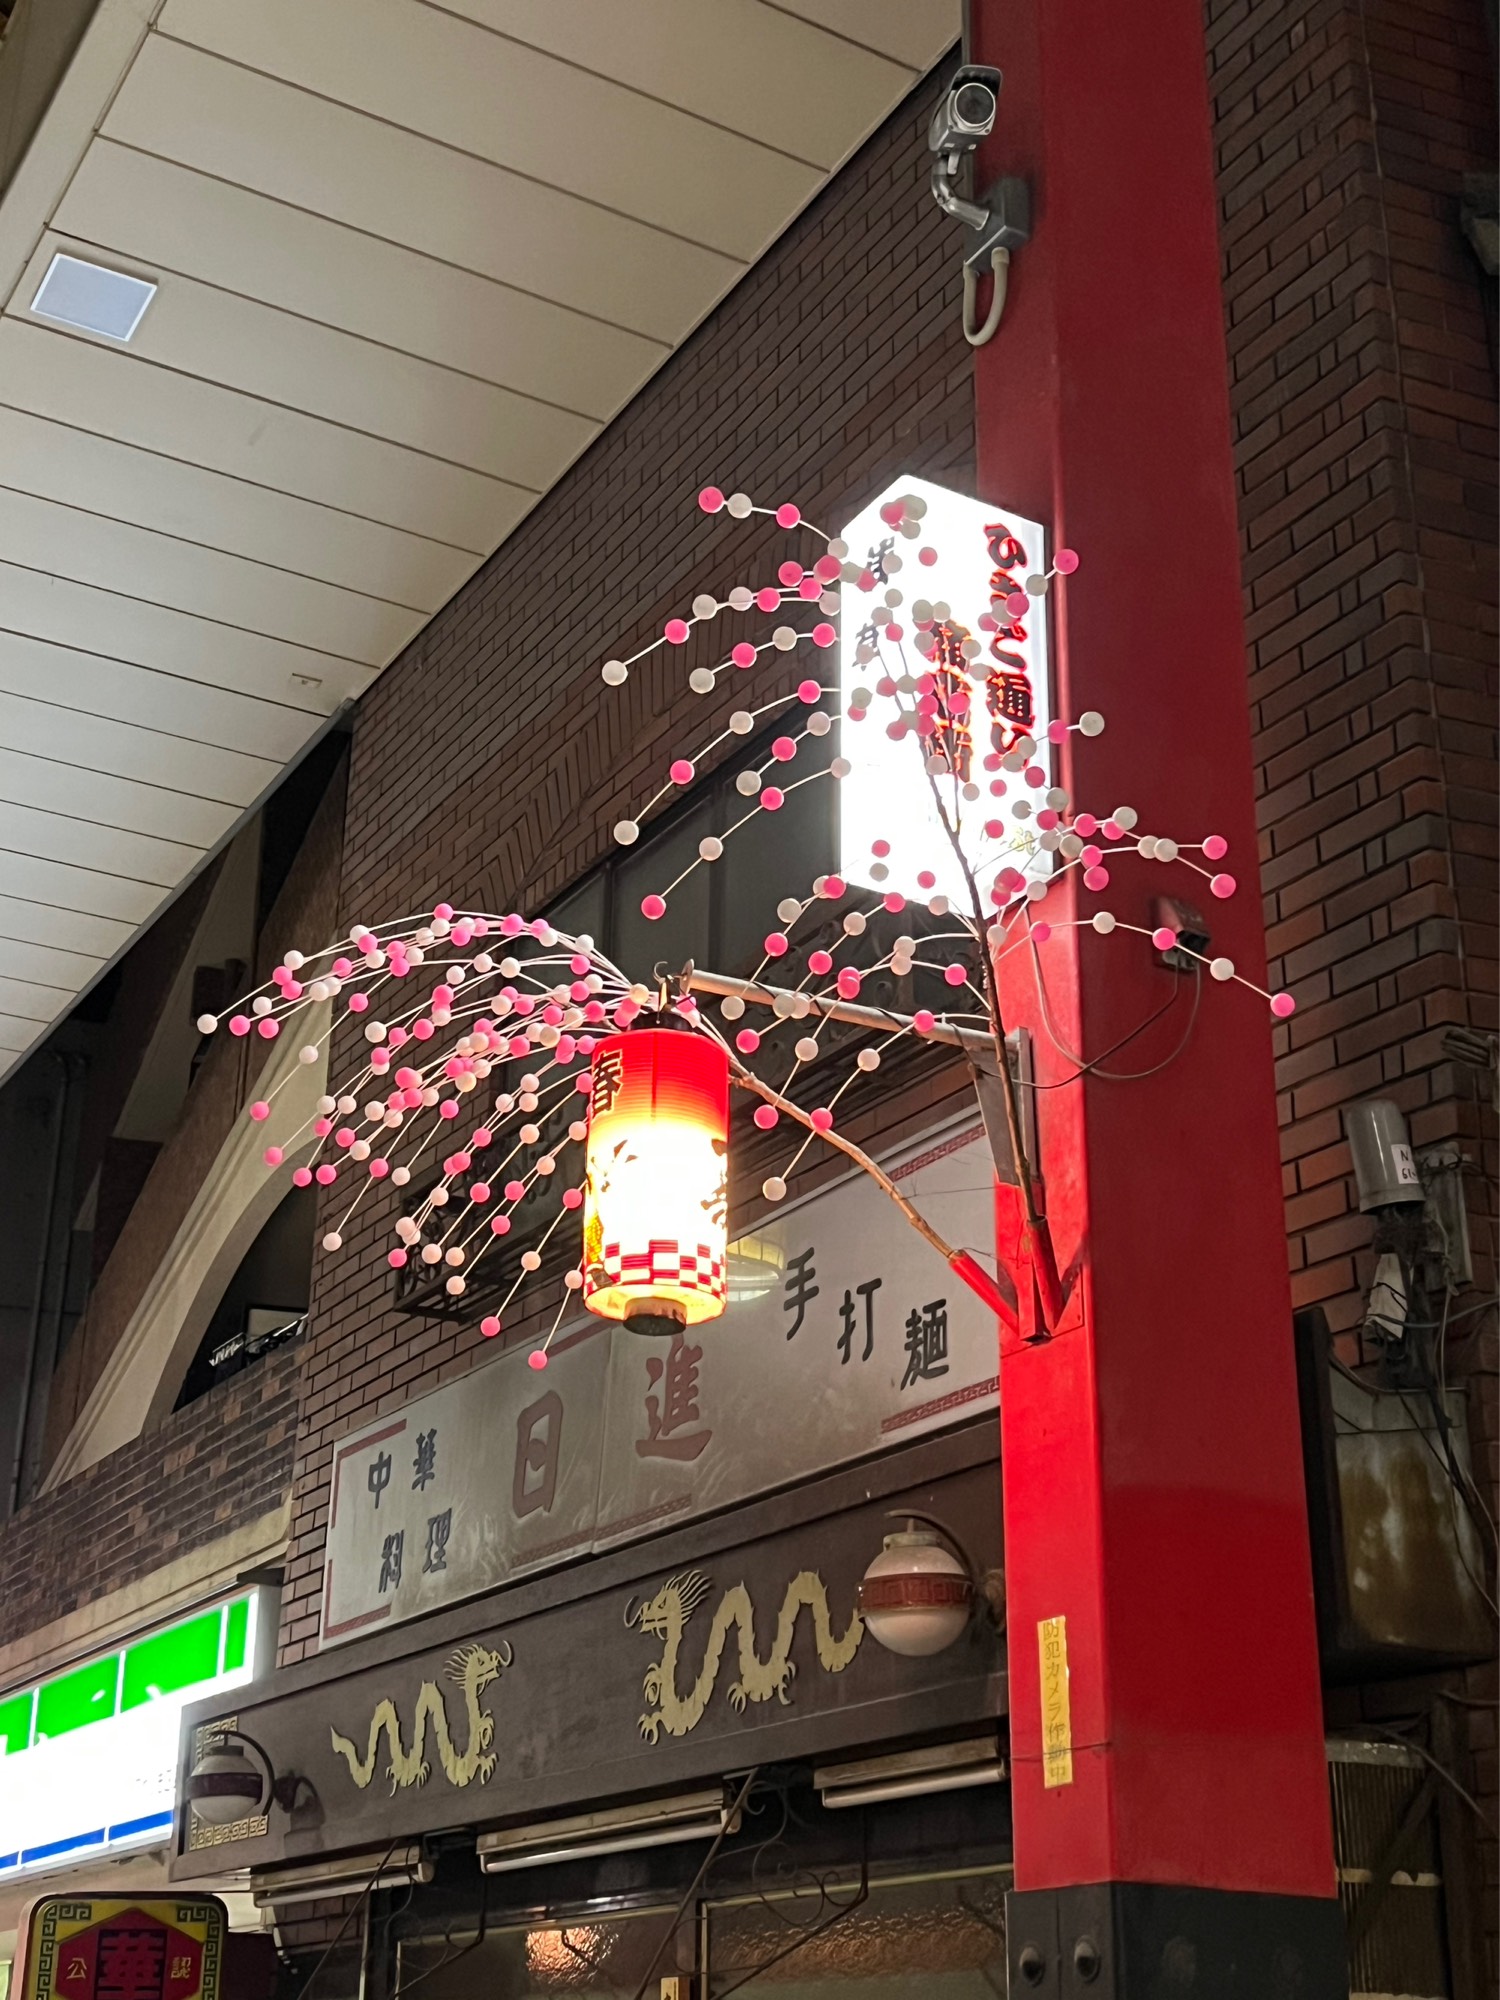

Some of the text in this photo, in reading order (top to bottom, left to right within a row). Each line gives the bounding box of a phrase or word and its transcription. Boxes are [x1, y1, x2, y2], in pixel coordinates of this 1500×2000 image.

[784, 1246, 949, 1391] 手打麺
[367, 1428, 437, 1509] 中華
[516, 1334, 712, 1518] 日進
[378, 1507, 452, 1593] 料理
